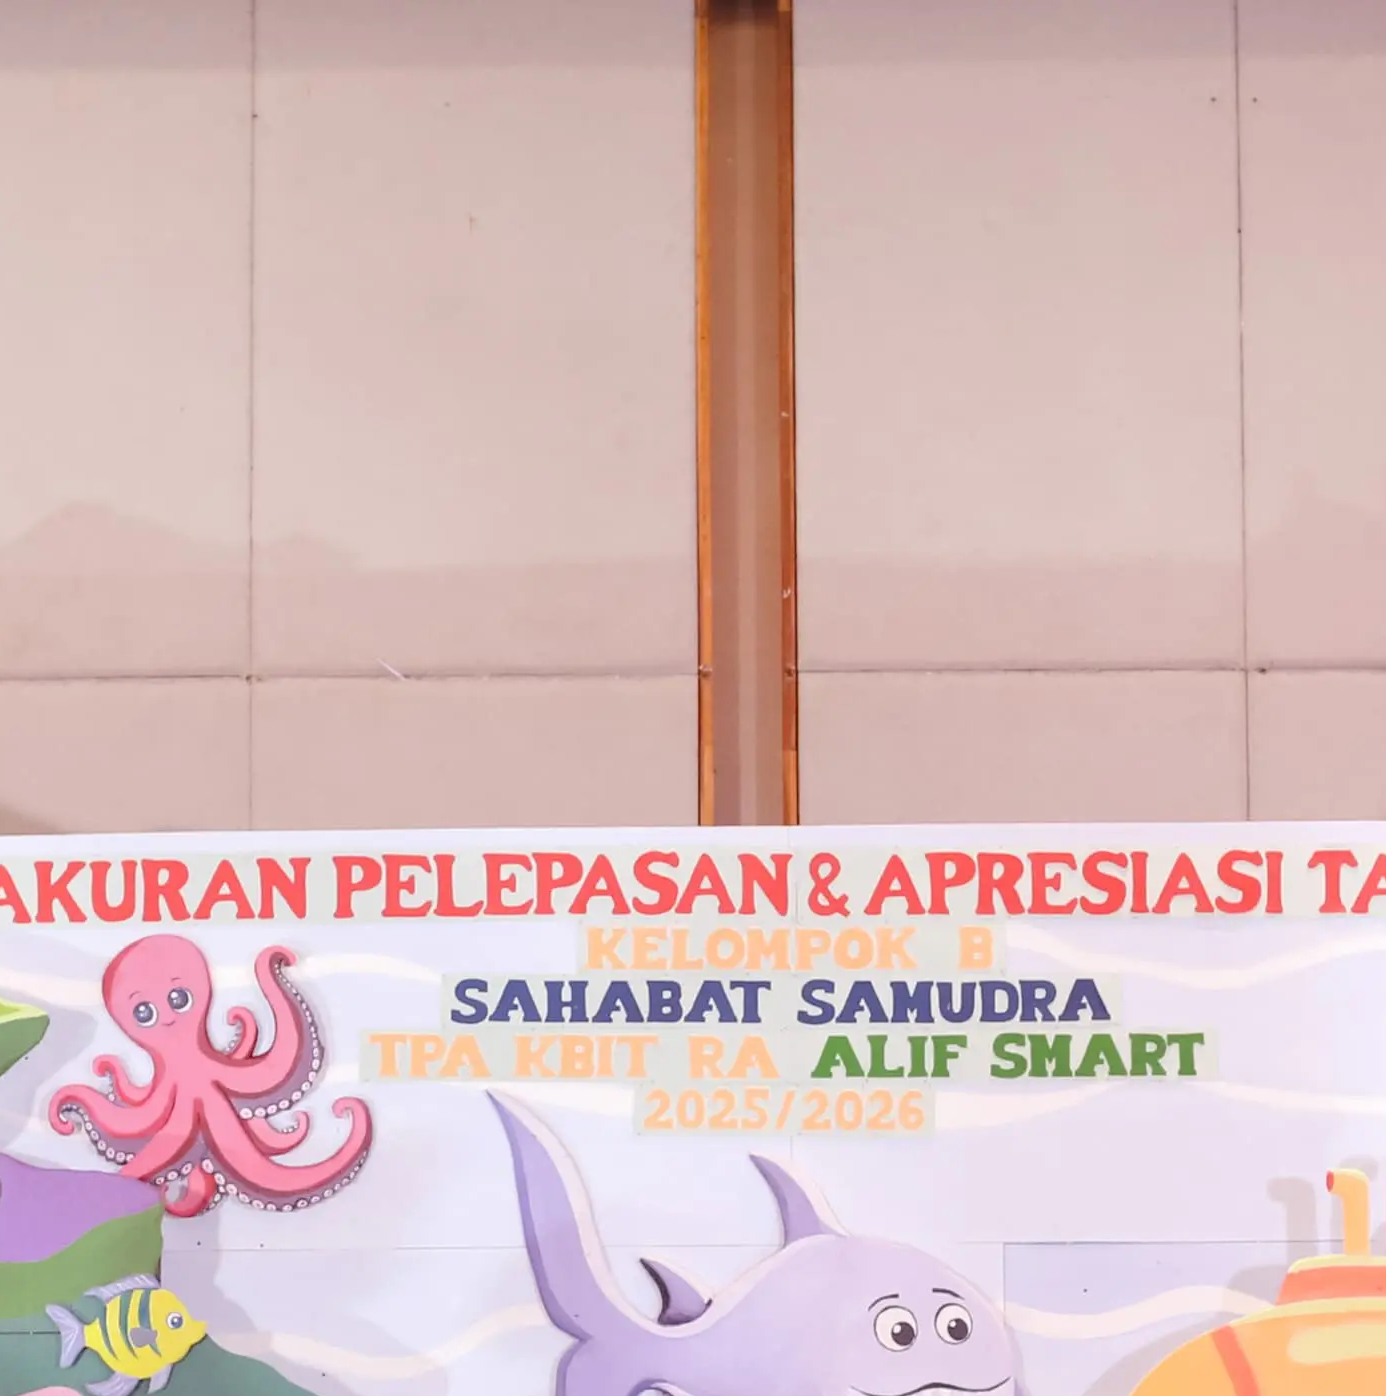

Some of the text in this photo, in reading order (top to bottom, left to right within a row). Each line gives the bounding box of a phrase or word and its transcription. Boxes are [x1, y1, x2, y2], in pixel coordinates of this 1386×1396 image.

[332, 850, 792, 920] PELEPASAN
[807, 852, 850, 918] &
[863, 848, 1284, 917] APRESIASI
[585, 926, 994, 971] KELOMPOK B
[450, 978, 1110, 1025] SAHABAT SAMUDRA
[368, 1032, 1205, 1079] TPA KBIT RA ALIF SMART
[642, 1087, 926, 1132] 2025/2026
